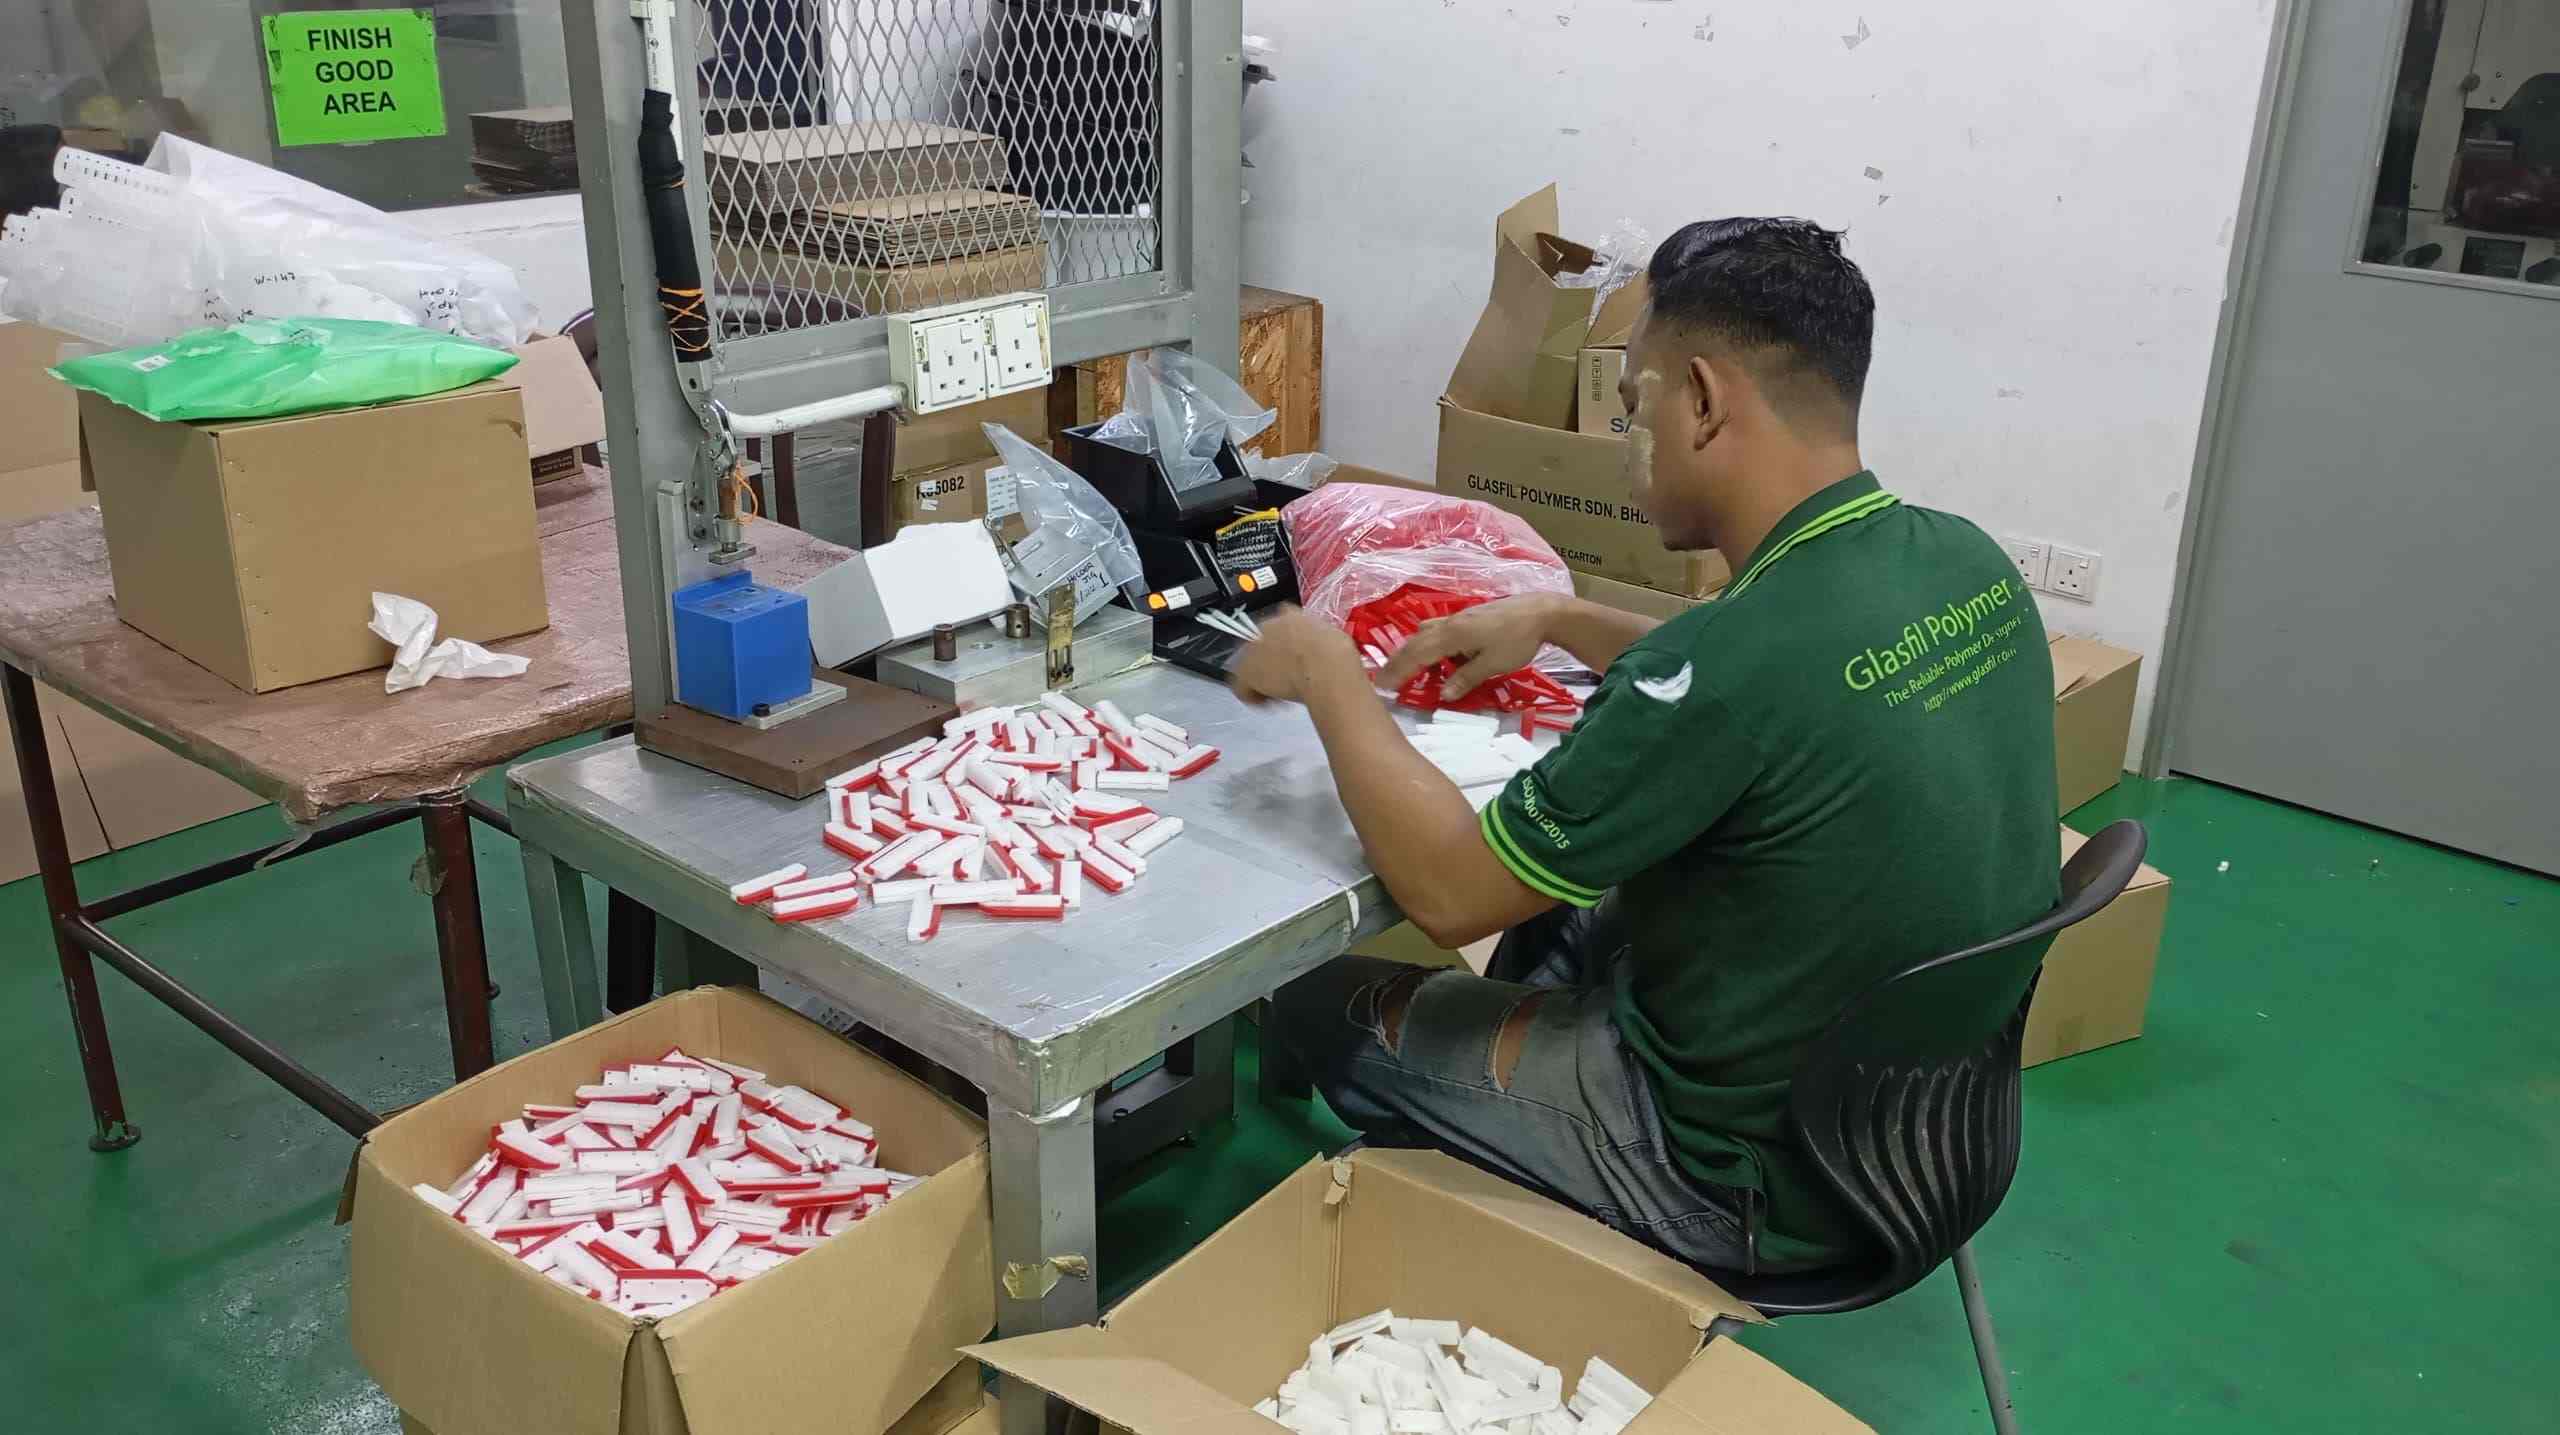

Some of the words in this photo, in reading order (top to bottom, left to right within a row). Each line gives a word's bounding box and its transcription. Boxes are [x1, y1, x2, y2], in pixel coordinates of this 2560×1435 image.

[307, 27, 392, 51] FINISH
[315, 59, 393, 83] GOOD
[323, 91, 396, 115] AREA
[1467, 474, 1517, 499] GLASFIL
[1520, 486, 1581, 513] POLYMER
[1584, 499, 1617, 519] SDN.
[1567, 550, 1602, 566] CARTON
[1844, 622, 1929, 690] Glasfil
[1923, 578, 2012, 646] Polymer
[1883, 690, 1912, 707] The
[1907, 663, 1945, 694] Reliable
[1943, 640, 1982, 671] Polymer
